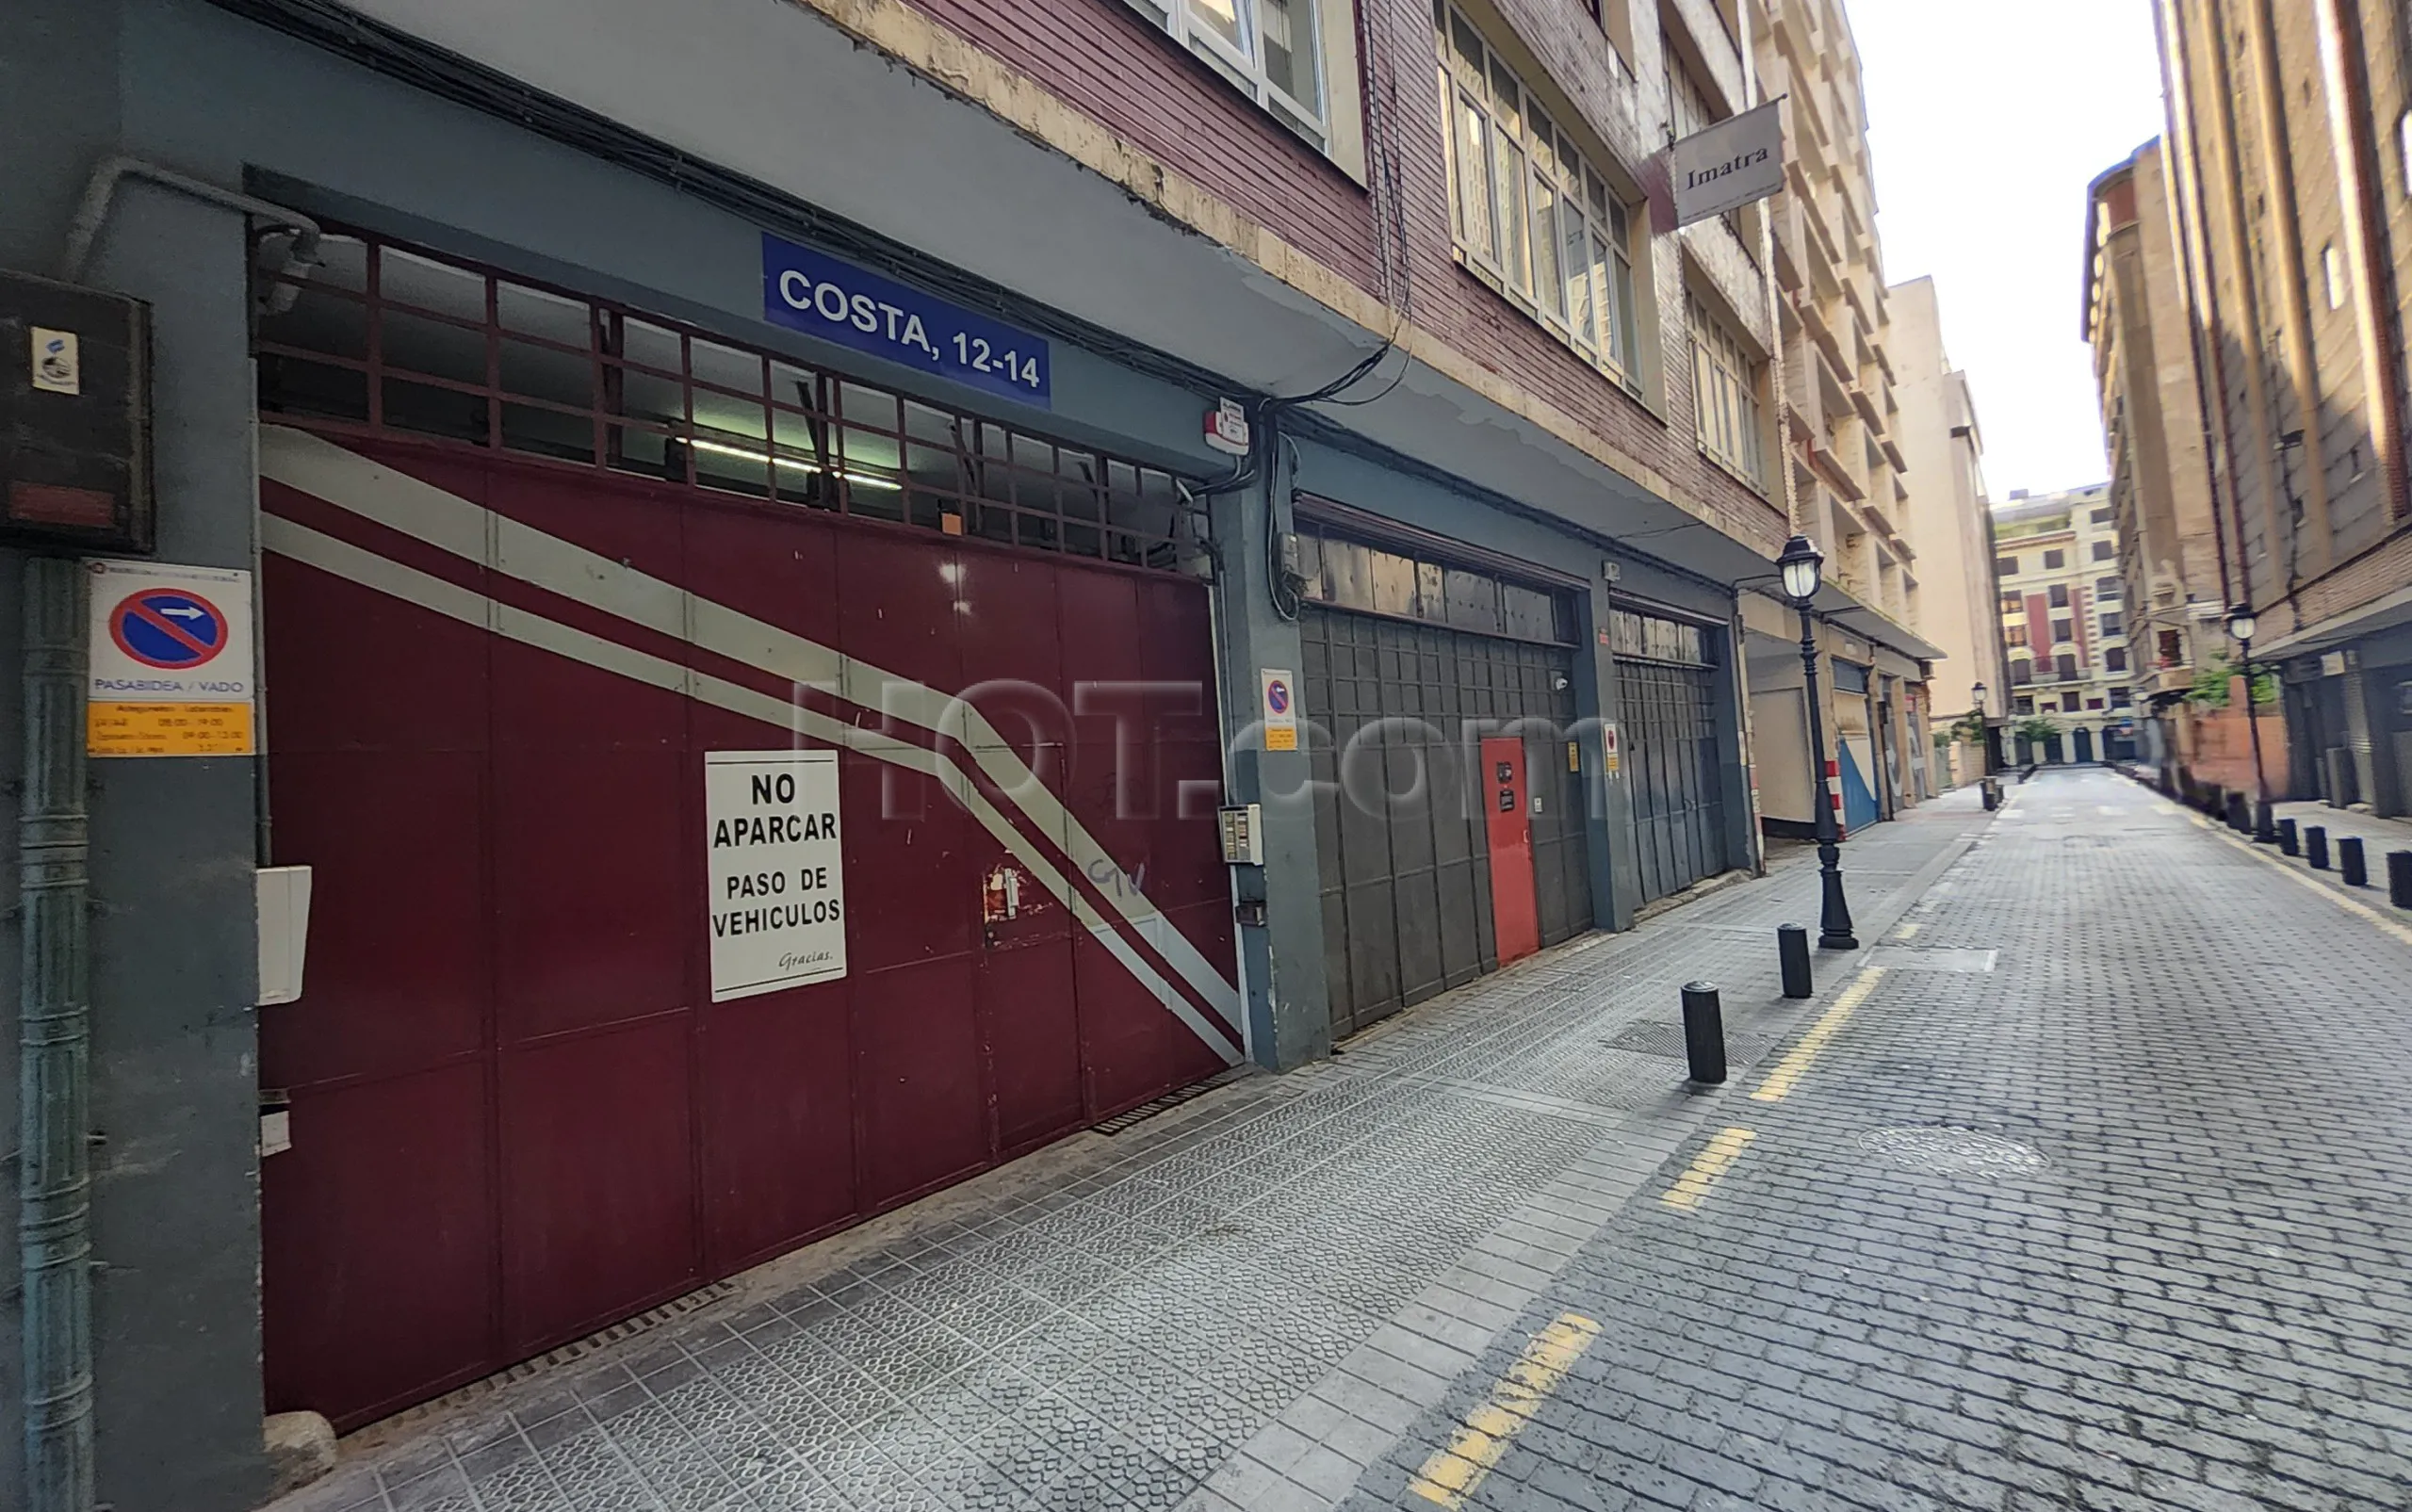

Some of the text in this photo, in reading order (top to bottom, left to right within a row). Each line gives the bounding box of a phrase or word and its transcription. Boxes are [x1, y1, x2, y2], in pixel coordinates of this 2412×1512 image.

[1686, 148, 1768, 190] Imatra
[779, 269, 1039, 388] COSTA, 12-14
[94, 679, 184, 691] PASABIDEA
[200, 681, 244, 692] VADO
[752, 773, 795, 805] NO
[713, 813, 837, 848] APARCAR
[726, 867, 827, 900] PASO DE
[712, 899, 840, 937] VEHICULOS
